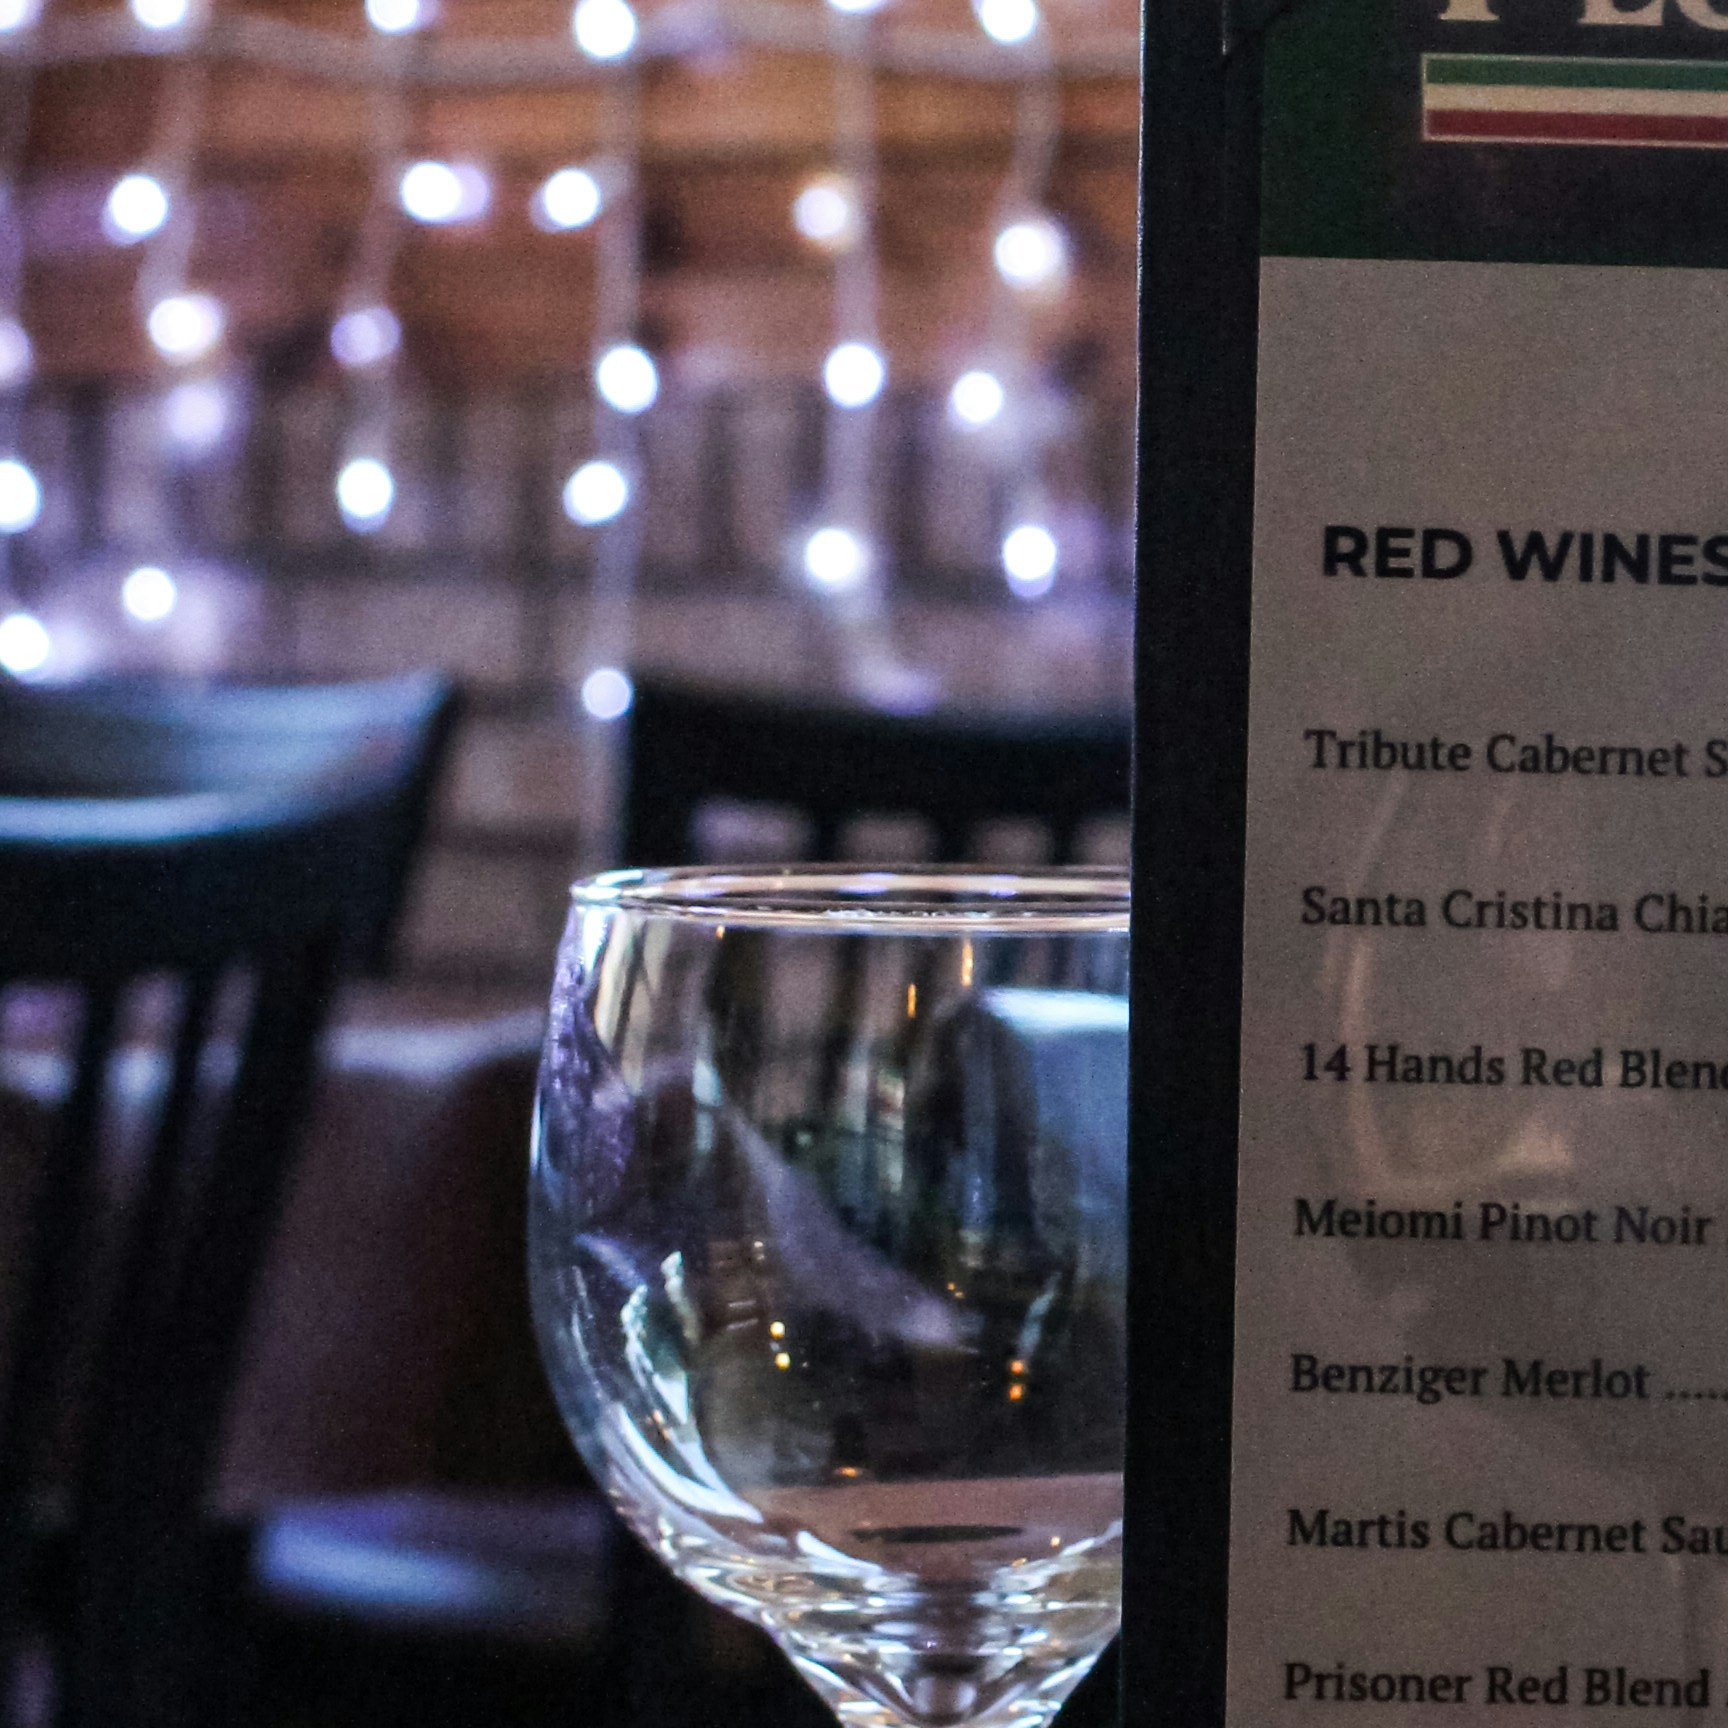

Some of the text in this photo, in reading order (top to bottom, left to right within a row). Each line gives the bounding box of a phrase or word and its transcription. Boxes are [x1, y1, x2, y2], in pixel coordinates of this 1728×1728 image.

[1322, 525, 1474, 580] RED
[1304, 729, 1472, 772] Tribute
[1486, 733, 1689, 778] Cabernet
[1300, 885, 1427, 928] Santa
[1440, 888, 1620, 932] Cristina
[1303, 1042, 1351, 1083] 14
[1365, 1043, 1505, 1086] Hands
[1520, 1046, 1604, 1088] Red
[1295, 1197, 1466, 1242] Meiomi
[1477, 1202, 1599, 1244] Pinot
[1613, 1205, 1713, 1246] Noir
[1291, 1353, 1649, 1405] Benziger Merlot
[1287, 1508, 1431, 1550] Martis
[1444, 1510, 1646, 1554] Cabernet
[1284, 1661, 1711, 1709] Prisoner Red Blend
